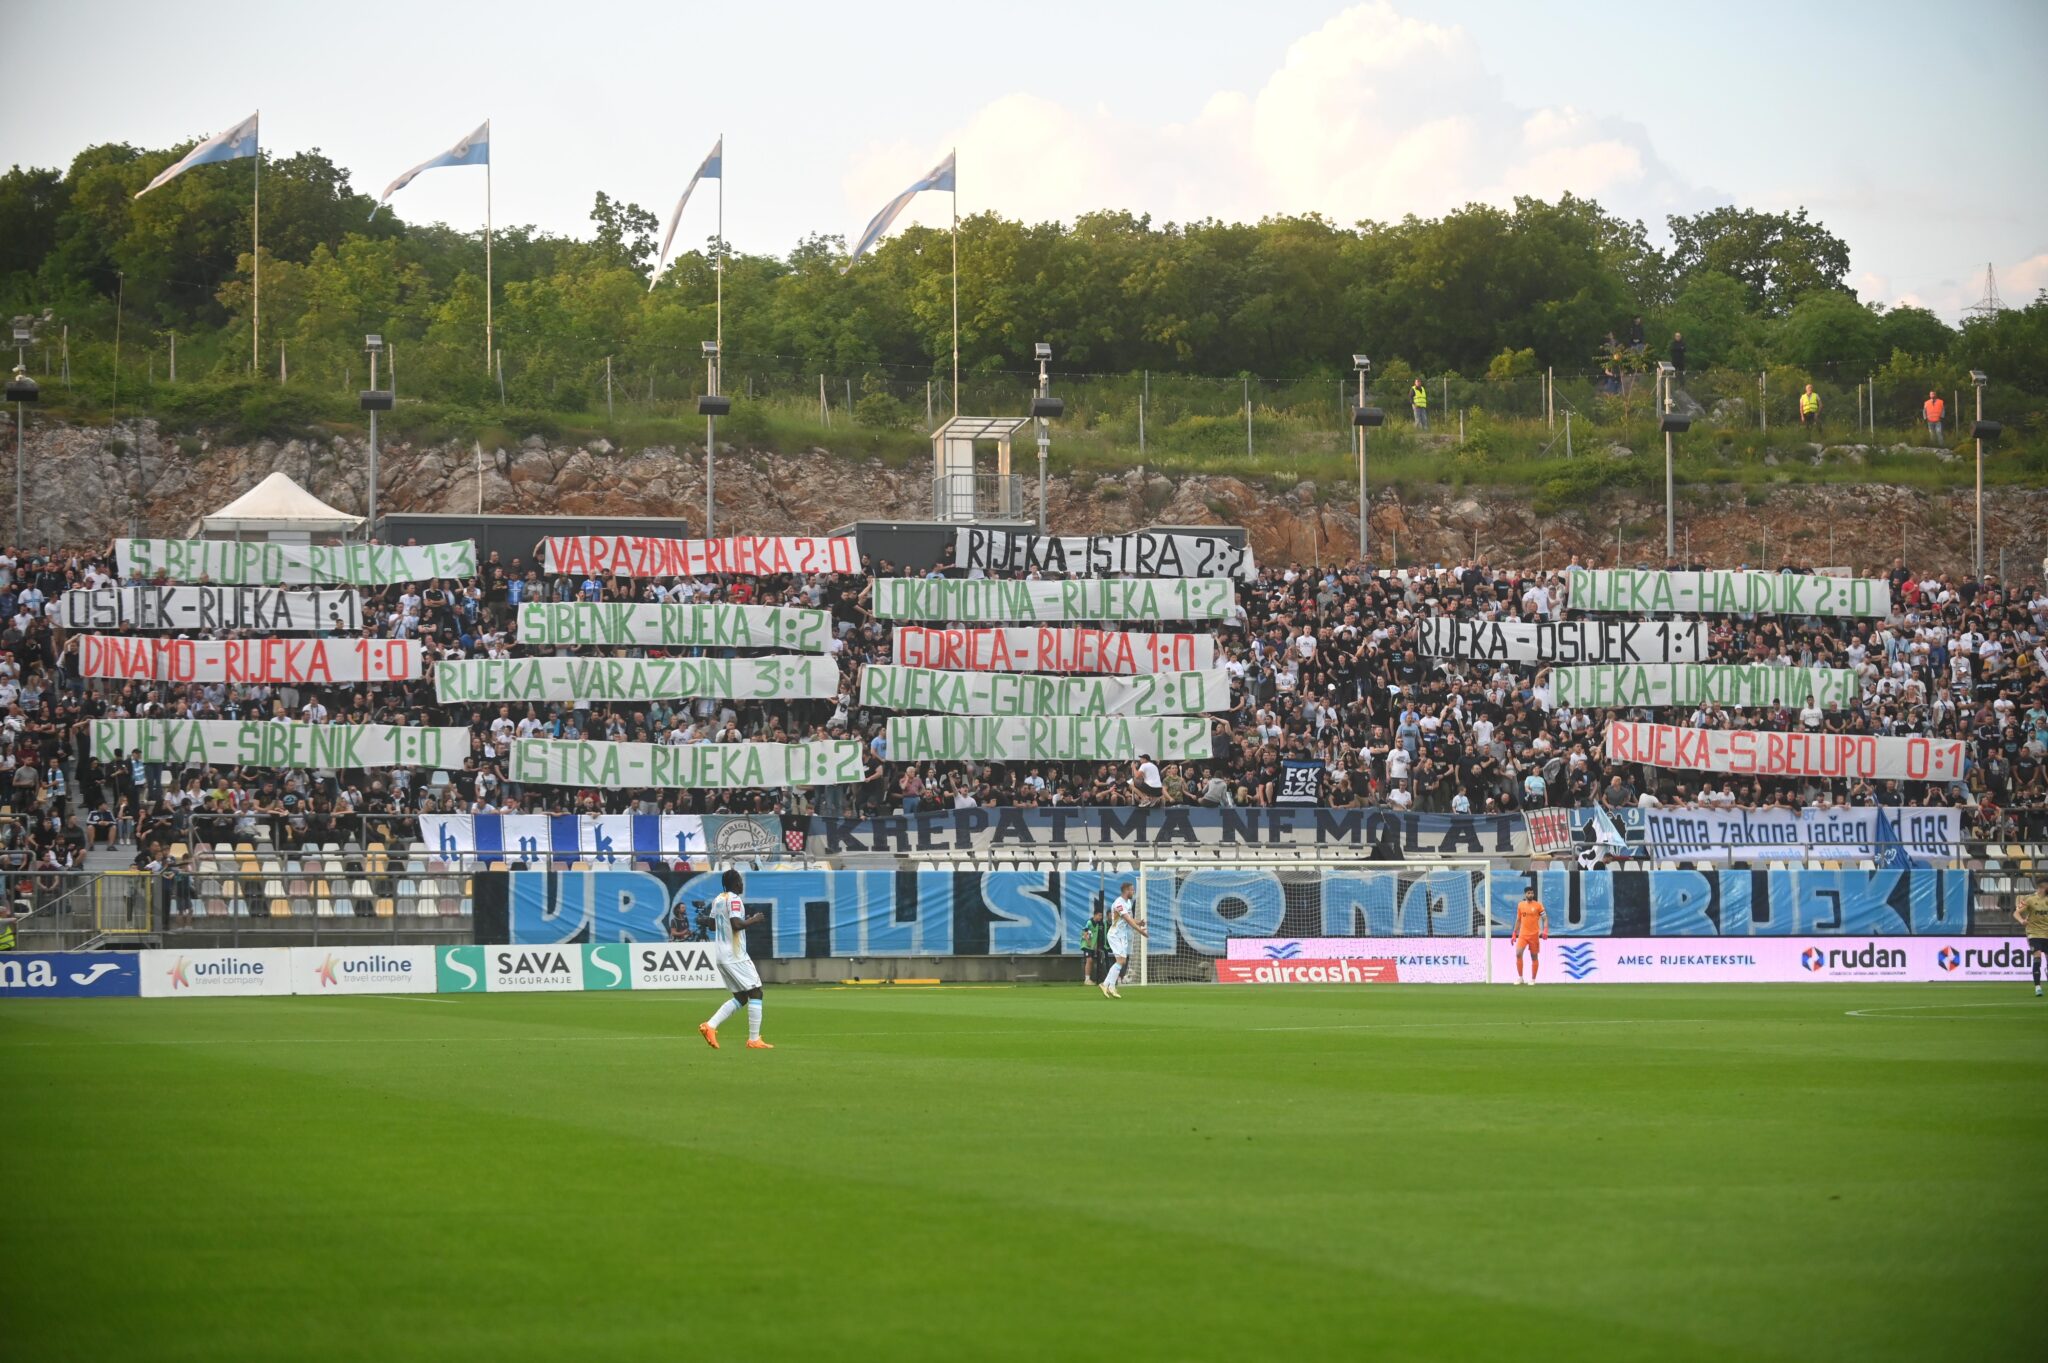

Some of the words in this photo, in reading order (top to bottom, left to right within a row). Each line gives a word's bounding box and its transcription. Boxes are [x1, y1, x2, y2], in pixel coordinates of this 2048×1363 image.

[423, 541, 475, 579] 1:3
[795, 537, 851, 574] 2:0
[307, 590, 355, 629] 1:1
[1175, 579, 1229, 619] 1:2
[1813, 576, 1871, 616] 2:0
[765, 610, 823, 652] 1:2
[1656, 621, 1700, 662] 1:1
[355, 639, 408, 681] 1:0
[1146, 634, 1195, 674] 1:0
[753, 657, 811, 697] 3:1
[1133, 671, 1205, 715] 2:0
[384, 726, 441, 768] 1:0
[1150, 718, 1206, 759] 1:2
[1906, 737, 1961, 779] 0:1
[785, 741, 859, 787] 0:2
[1286, 768, 1320, 782] FCK
[1100, 806, 1200, 848] MA
[1219, 806, 1297, 848] NE
[1648, 814, 1710, 857] nema
[1719, 811, 1798, 846] zakona
[1911, 815, 1950, 856] nas
[1650, 869, 1969, 936] RIJEKU
[194, 957, 265, 976] uniline
[343, 954, 412, 973] uniline
[498, 951, 571, 975] SAVA
[642, 949, 715, 972] SAVA
[1254, 959, 1362, 983] aircash
[1617, 955, 1653, 965] AMEC
[1660, 955, 1756, 965] RIJEKATEKSTIL
[1829, 941, 1907, 968] rudan
[195, 975, 219, 985] travel
[222, 976, 264, 987] company
[344, 973, 368, 983] travel
[371, 974, 412, 985] company
[498, 976, 572, 985] OSIGURANJE
[643, 973, 716, 982] OSIGURANJE
